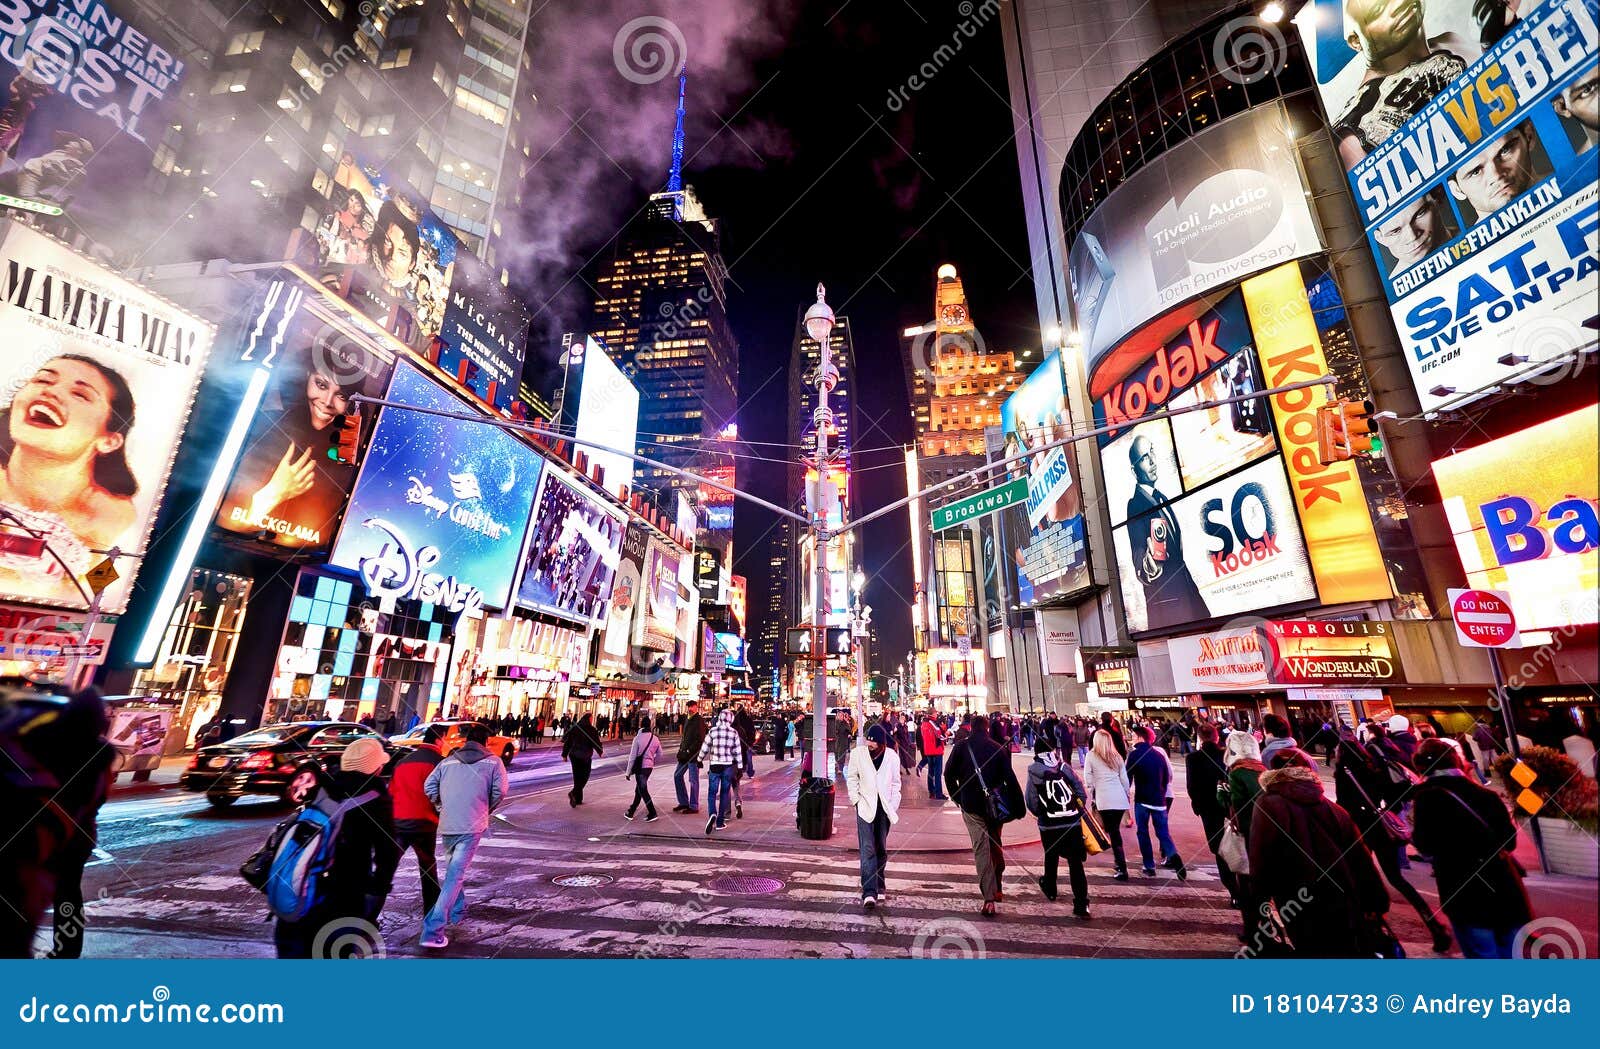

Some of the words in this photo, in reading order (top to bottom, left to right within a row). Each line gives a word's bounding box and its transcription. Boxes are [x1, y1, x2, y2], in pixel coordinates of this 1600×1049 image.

[56, 3, 107, 47] TONY
[0, 0, 163, 116] BEST
[0, 34, 147, 143] USICAL
[1353, 132, 1404, 176] WORLD
[1408, 11, 1541, 132] MIDDLEWEIGHT
[1357, 108, 1467, 223] SILVA
[1444, 62, 1518, 145] VS
[1153, 212, 1200, 247] Tivoli
[1207, 185, 1269, 220] Audio
[1156, 246, 1169, 256] The
[1170, 230, 1200, 250] Original
[1201, 216, 1227, 232] Radio
[1392, 246, 1454, 298] GRIFFIN
[1466, 177, 1563, 254] FRANKLIN
[1520, 212, 1561, 238] PRESENTED
[1159, 284, 1191, 306] 10th
[1193, 242, 1298, 289] Anniversary
[1405, 239, 1552, 342] SAT.
[0, 258, 125, 344] MAMMA
[132, 311, 196, 367] MIA!
[453, 291, 522, 362] MICHAEL
[1414, 315, 1483, 362] LIVE
[1486, 284, 1543, 323] ON
[456, 323, 474, 344] THE
[473, 338, 492, 358] NEW
[490, 354, 514, 379] ALBUM
[460, 342, 499, 380] DECEMBER
[1102, 318, 1230, 438] Kodak
[1421, 347, 1461, 374] UFC.COM
[1267, 343, 1352, 511] Kodak
[944, 488, 1014, 523] Broadway
[1026, 481, 1047, 516] HALL
[1043, 453, 1067, 493] PASS
[1202, 481, 1274, 563] SO
[1211, 529, 1281, 578] Kodak
[1273, 622, 1386, 636] MARQUIS
[1460, 600, 1476, 611] DO
[1479, 600, 1500, 611] NOT
[1469, 625, 1505, 637] ENTER
[1199, 627, 1261, 662] Marriot
[1283, 657, 1393, 679] WONDERLAND
